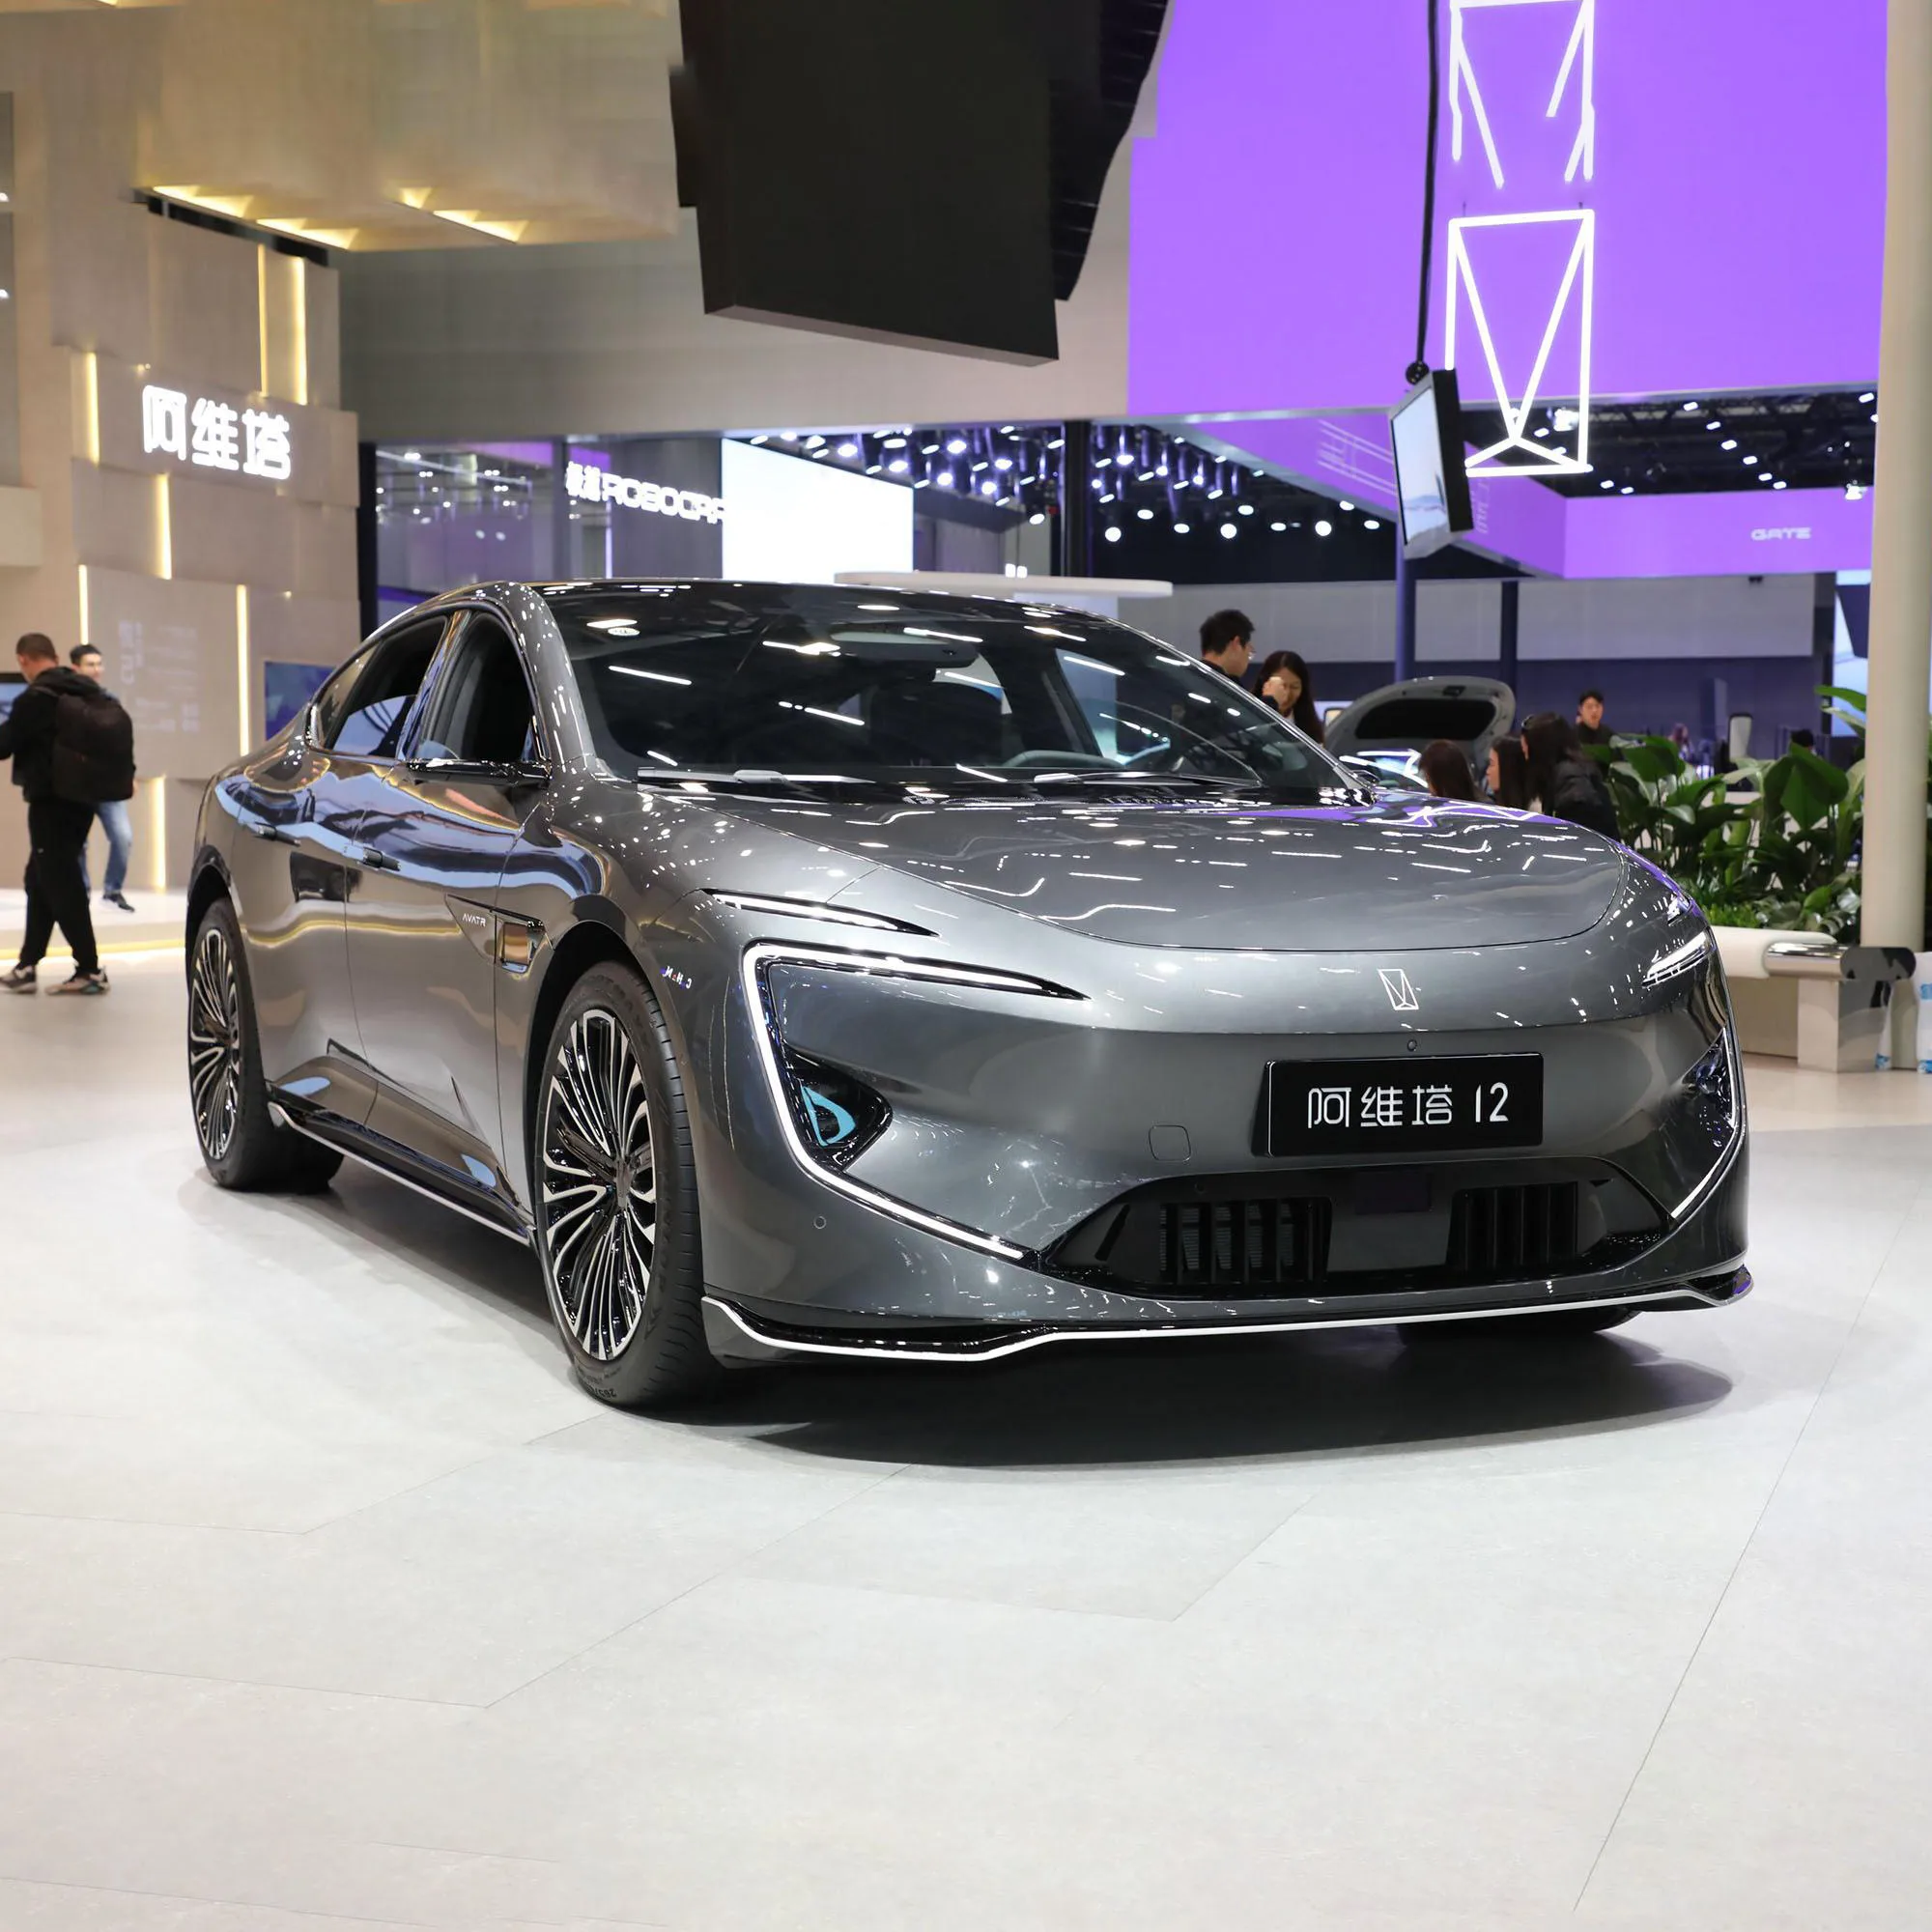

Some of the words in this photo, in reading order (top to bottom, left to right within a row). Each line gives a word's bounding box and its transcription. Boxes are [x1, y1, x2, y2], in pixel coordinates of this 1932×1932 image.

[142, 385, 291, 479] 阿维塔
[1750, 526, 1812, 541] GATE
[1308, 1085, 1453, 1128] 阿维塔
[1475, 1082, 1509, 1122] 12
